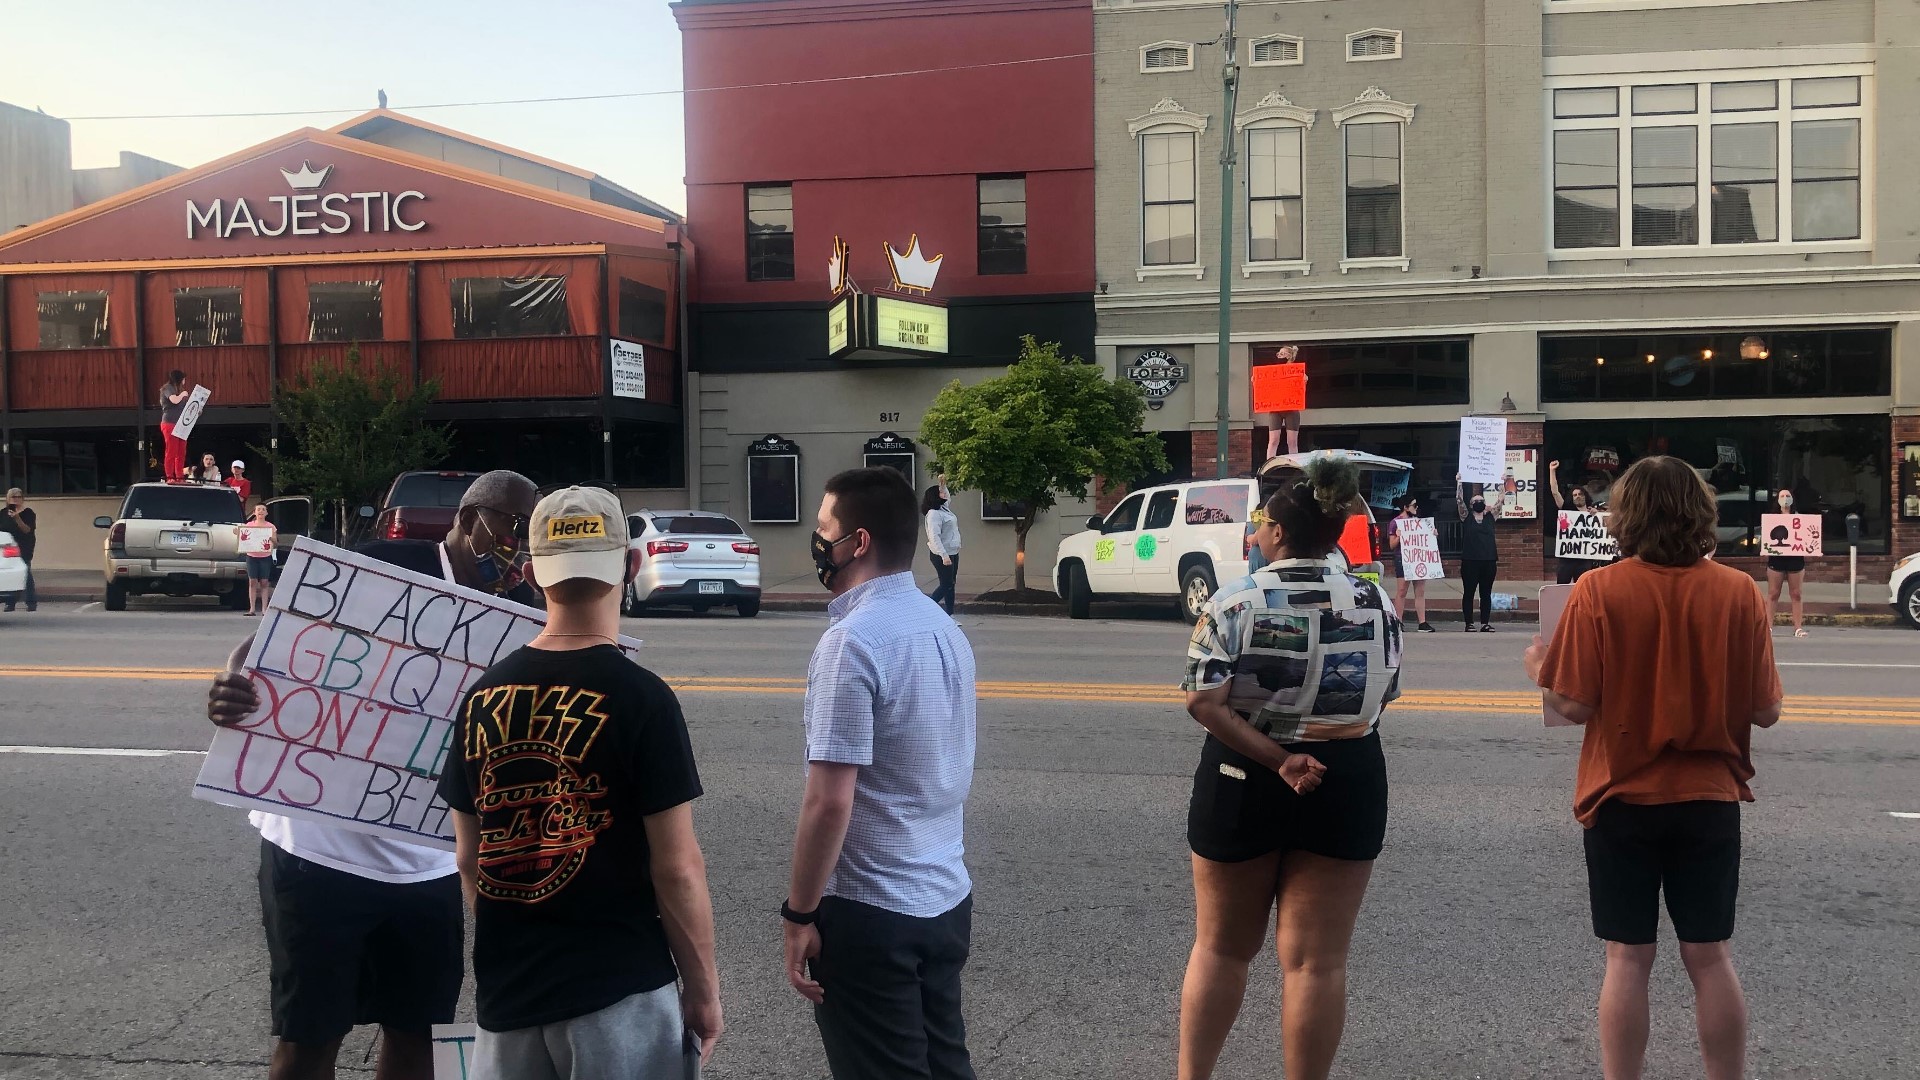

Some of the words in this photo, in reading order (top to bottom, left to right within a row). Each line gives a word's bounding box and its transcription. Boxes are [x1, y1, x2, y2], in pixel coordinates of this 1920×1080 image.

[186, 190, 426, 239] MAJESTIC
[898, 319, 916, 332] FOLLOW
[916, 322, 923, 333] US
[898, 331, 915, 344] SOCIAL
[1140, 350, 1172, 362] IVORY
[1129, 367, 1182, 379] LOFTS
[879, 412, 900, 423] 817
[755, 443, 790, 451] MAJESTIC
[1403, 519, 1423, 532] HEX
[1401, 533, 1429, 548] WHITE
[288, 553, 494, 663] BLACK
[465, 684, 610, 763] KISS
[234, 732, 337, 807] US
[540, 799, 614, 841] City
